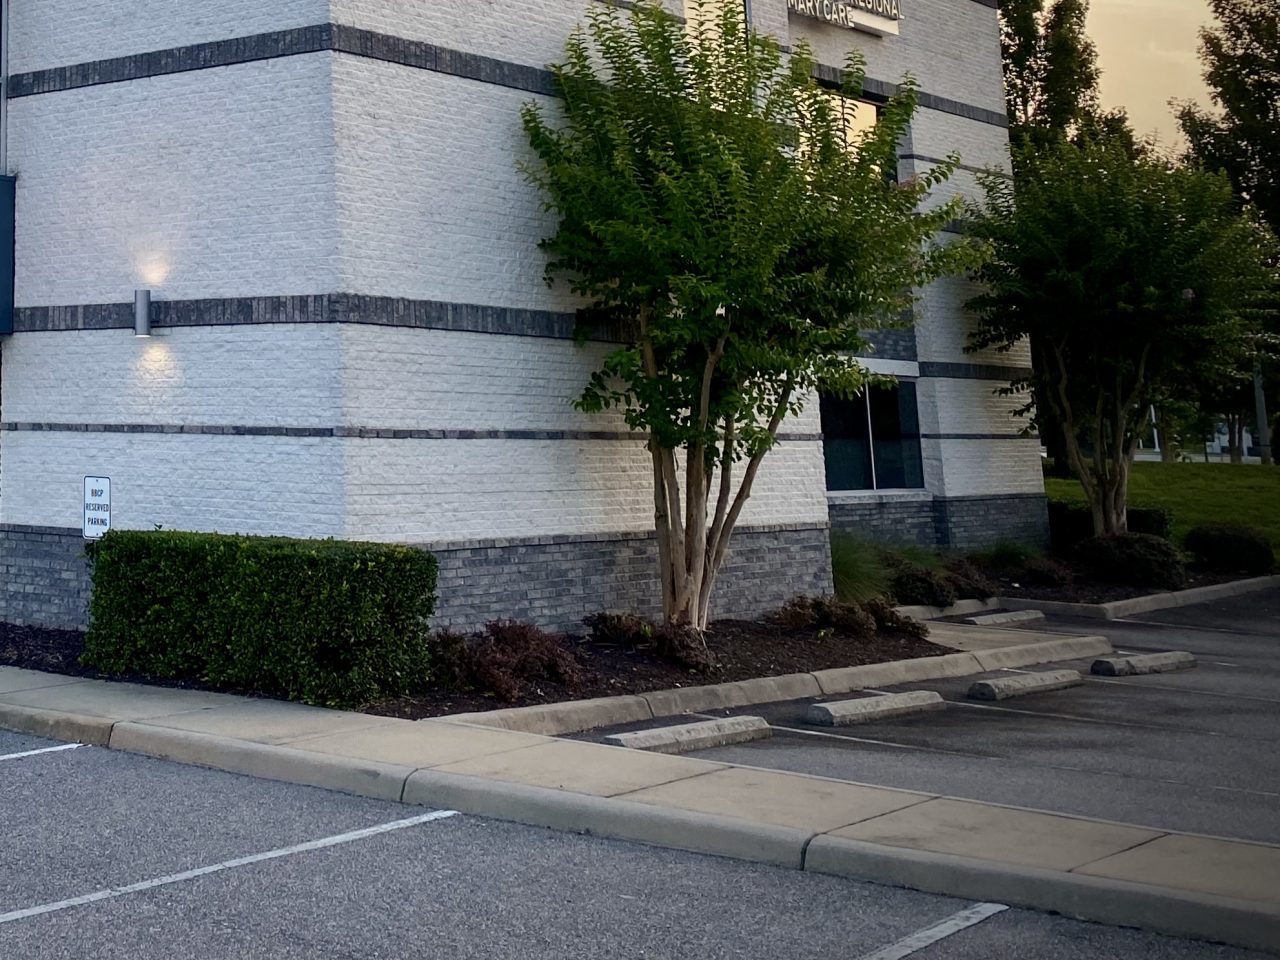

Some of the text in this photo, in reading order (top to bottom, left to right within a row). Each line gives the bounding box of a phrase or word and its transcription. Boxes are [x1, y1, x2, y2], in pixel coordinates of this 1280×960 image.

[823, 0, 855, 28] CARE
[85, 502, 110, 513] RESERVED
[87, 517, 108, 527] PARKING
